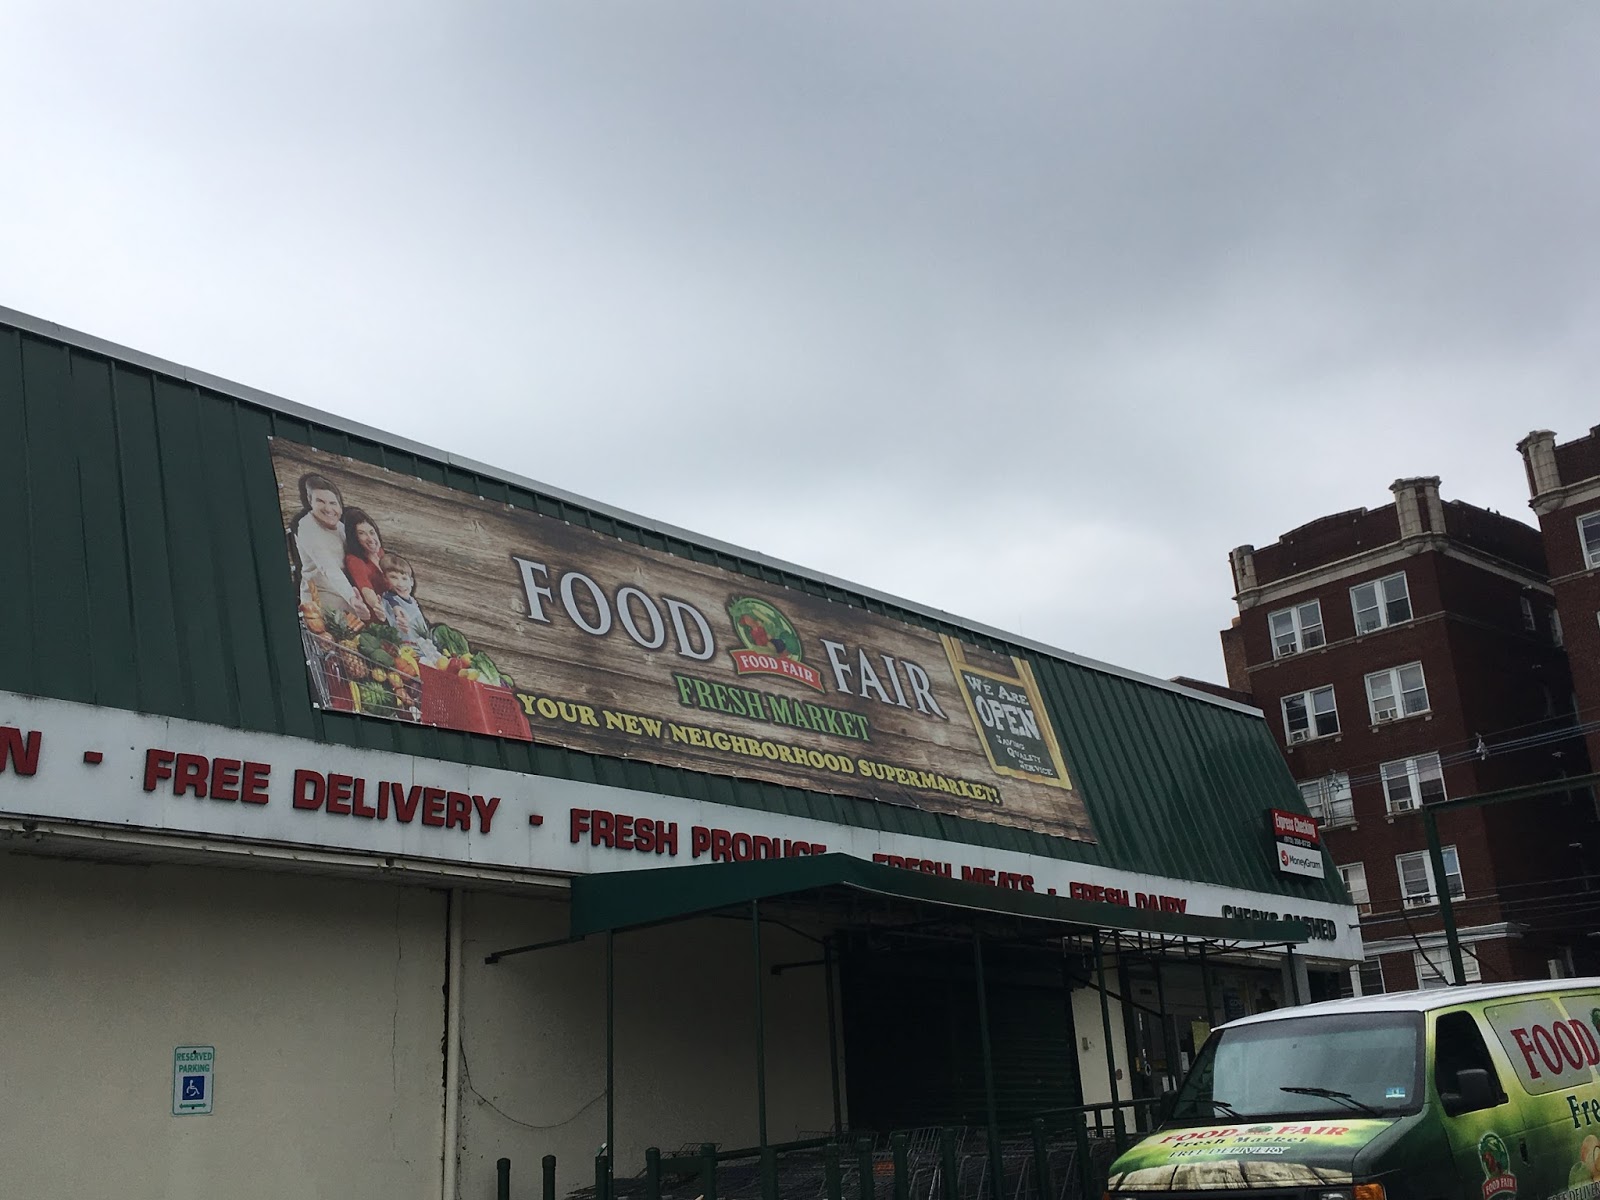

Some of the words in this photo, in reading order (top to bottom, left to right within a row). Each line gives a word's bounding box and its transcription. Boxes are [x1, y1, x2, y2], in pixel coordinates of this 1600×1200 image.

[513, 557, 715, 660] FOOD
[820, 639, 948, 719] FAIR
[740, 655, 778, 670] FOOD
[781, 660, 814, 682] FAIR
[964, 675, 994, 696] WE
[998, 686, 1029, 706] ARE
[674, 675, 768, 720] FRESH
[767, 695, 870, 742] MARKET
[975, 695, 1042, 740] OPEN
[517, 693, 600, 727] YOUR
[602, 711, 663, 739] NEW
[669, 722, 855, 774] NEIGHBORHOOD
[858, 759, 1000, 804] SUPERMARKET!
[143, 749, 271, 804] FREE
[293, 769, 501, 833] DELIVERY
[570, 808, 678, 856] FRESH
[1283, 913, 1338, 941] SHED
[1290, 855, 1321, 868] MoneyGram
[176, 1052, 213, 1062] RESERVED
[1510, 1018, 1600, 1080] FOOD
[179, 1064, 210, 1073] PARKING
[1160, 1128, 1239, 1144] FOOD
[1276, 1125, 1350, 1136] FAIR
[1172, 1138, 1226, 1148] Fresh
[1234, 1136, 1308, 1144] Market
[1485, 1179, 1500, 1195] FOOD
